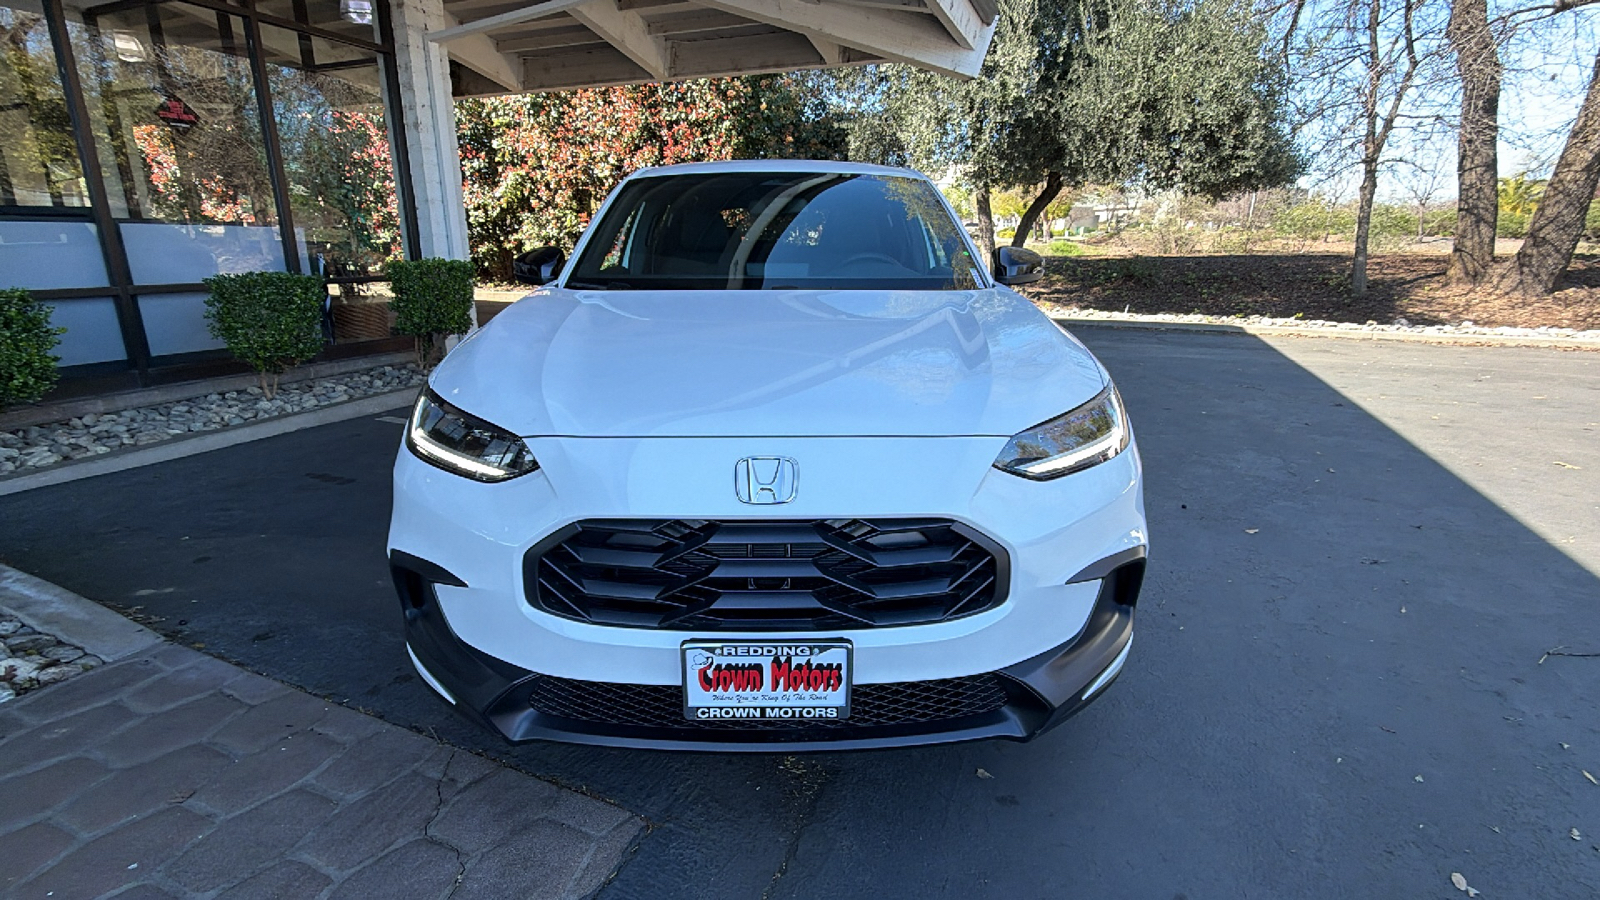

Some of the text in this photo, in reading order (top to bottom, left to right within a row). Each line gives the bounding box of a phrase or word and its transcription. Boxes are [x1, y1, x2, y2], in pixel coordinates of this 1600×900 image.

[723, 646, 811, 656] REDDING
[698, 656, 843, 692] Crown Motors
[761, 694, 779, 702] King
[781, 694, 791, 702] Of
[793, 693, 806, 701] The
[808, 693, 829, 701] Road
[697, 707, 838, 718] CROWN MOTORS
